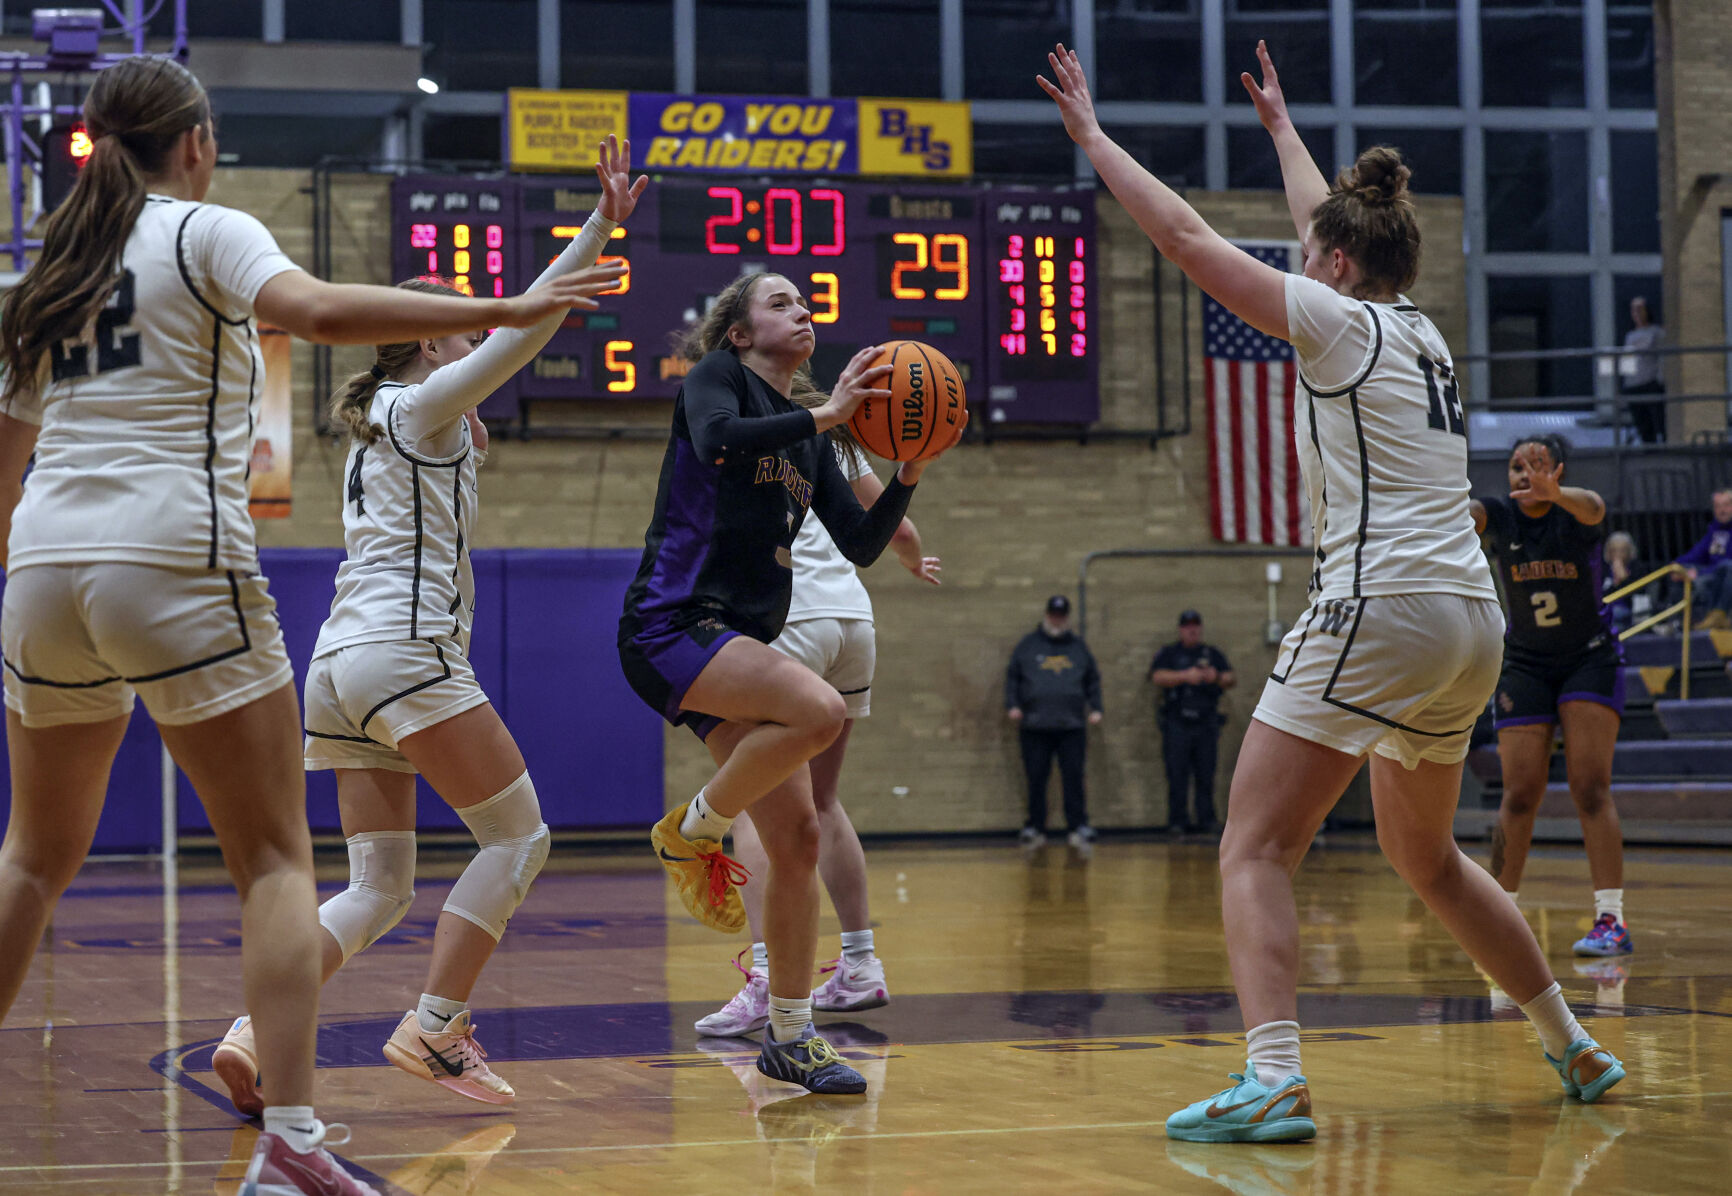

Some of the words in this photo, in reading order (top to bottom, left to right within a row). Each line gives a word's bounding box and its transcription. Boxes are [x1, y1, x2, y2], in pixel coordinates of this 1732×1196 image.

[659, 101, 725, 133] GO
[745, 104, 834, 136] YOU
[644, 136, 846, 171] RAIDERS!
[878, 108, 952, 170] BHS
[486, 225, 503, 249] 0
[1008, 235, 1024, 258] 2
[1035, 236, 1055, 258] 11
[1075, 237, 1085, 258] 1
[428, 250, 438, 273] 1
[486, 250, 503, 274] 0
[891, 232, 969, 301] 29
[810, 272, 839, 324] 3
[1070, 284, 1085, 308] 2
[1071, 333, 1086, 357] 2
[605, 340, 636, 392] 5
[901, 362, 924, 442] Wilson
[1530, 591, 1562, 627] 2
